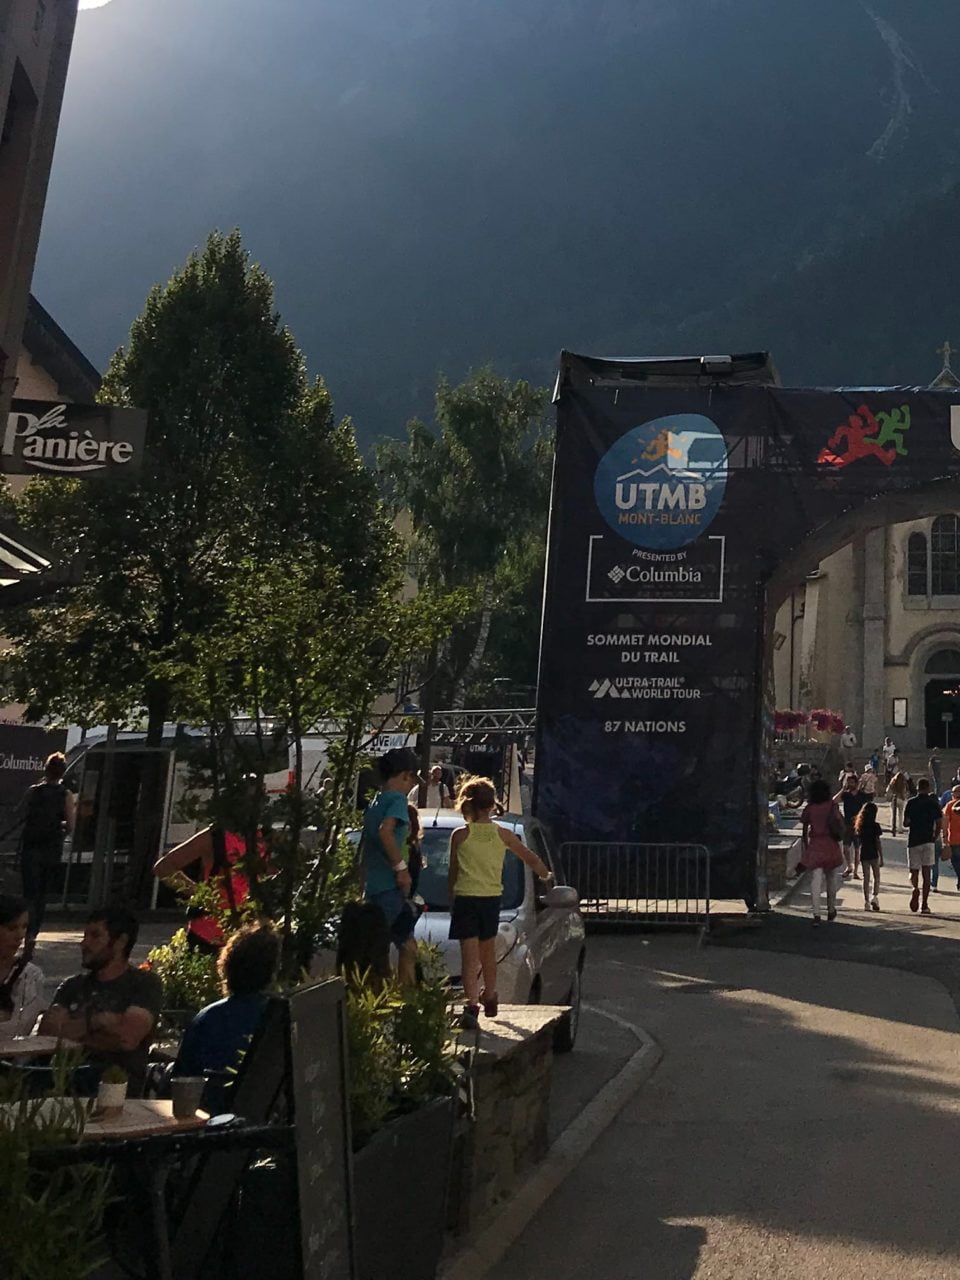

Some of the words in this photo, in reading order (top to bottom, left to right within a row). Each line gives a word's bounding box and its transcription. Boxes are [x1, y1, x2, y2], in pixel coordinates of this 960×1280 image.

[2, 412, 134, 464] Panière
[618, 513, 702, 525] MONT-BLANC
[631, 549, 676, 562] PRESENTED
[677, 551, 688, 561] BY
[625, 566, 702, 583] Columbia
[587, 634, 645, 646] SOMMET
[647, 634, 713, 646] MONDIAL
[621, 651, 640, 663] DU
[643, 651, 680, 663] TRAIL
[631, 688, 671, 699] WORLD
[672, 688, 701, 699] TOUR
[604, 721, 622, 733] 87
[624, 721, 687, 733] NATIONS
